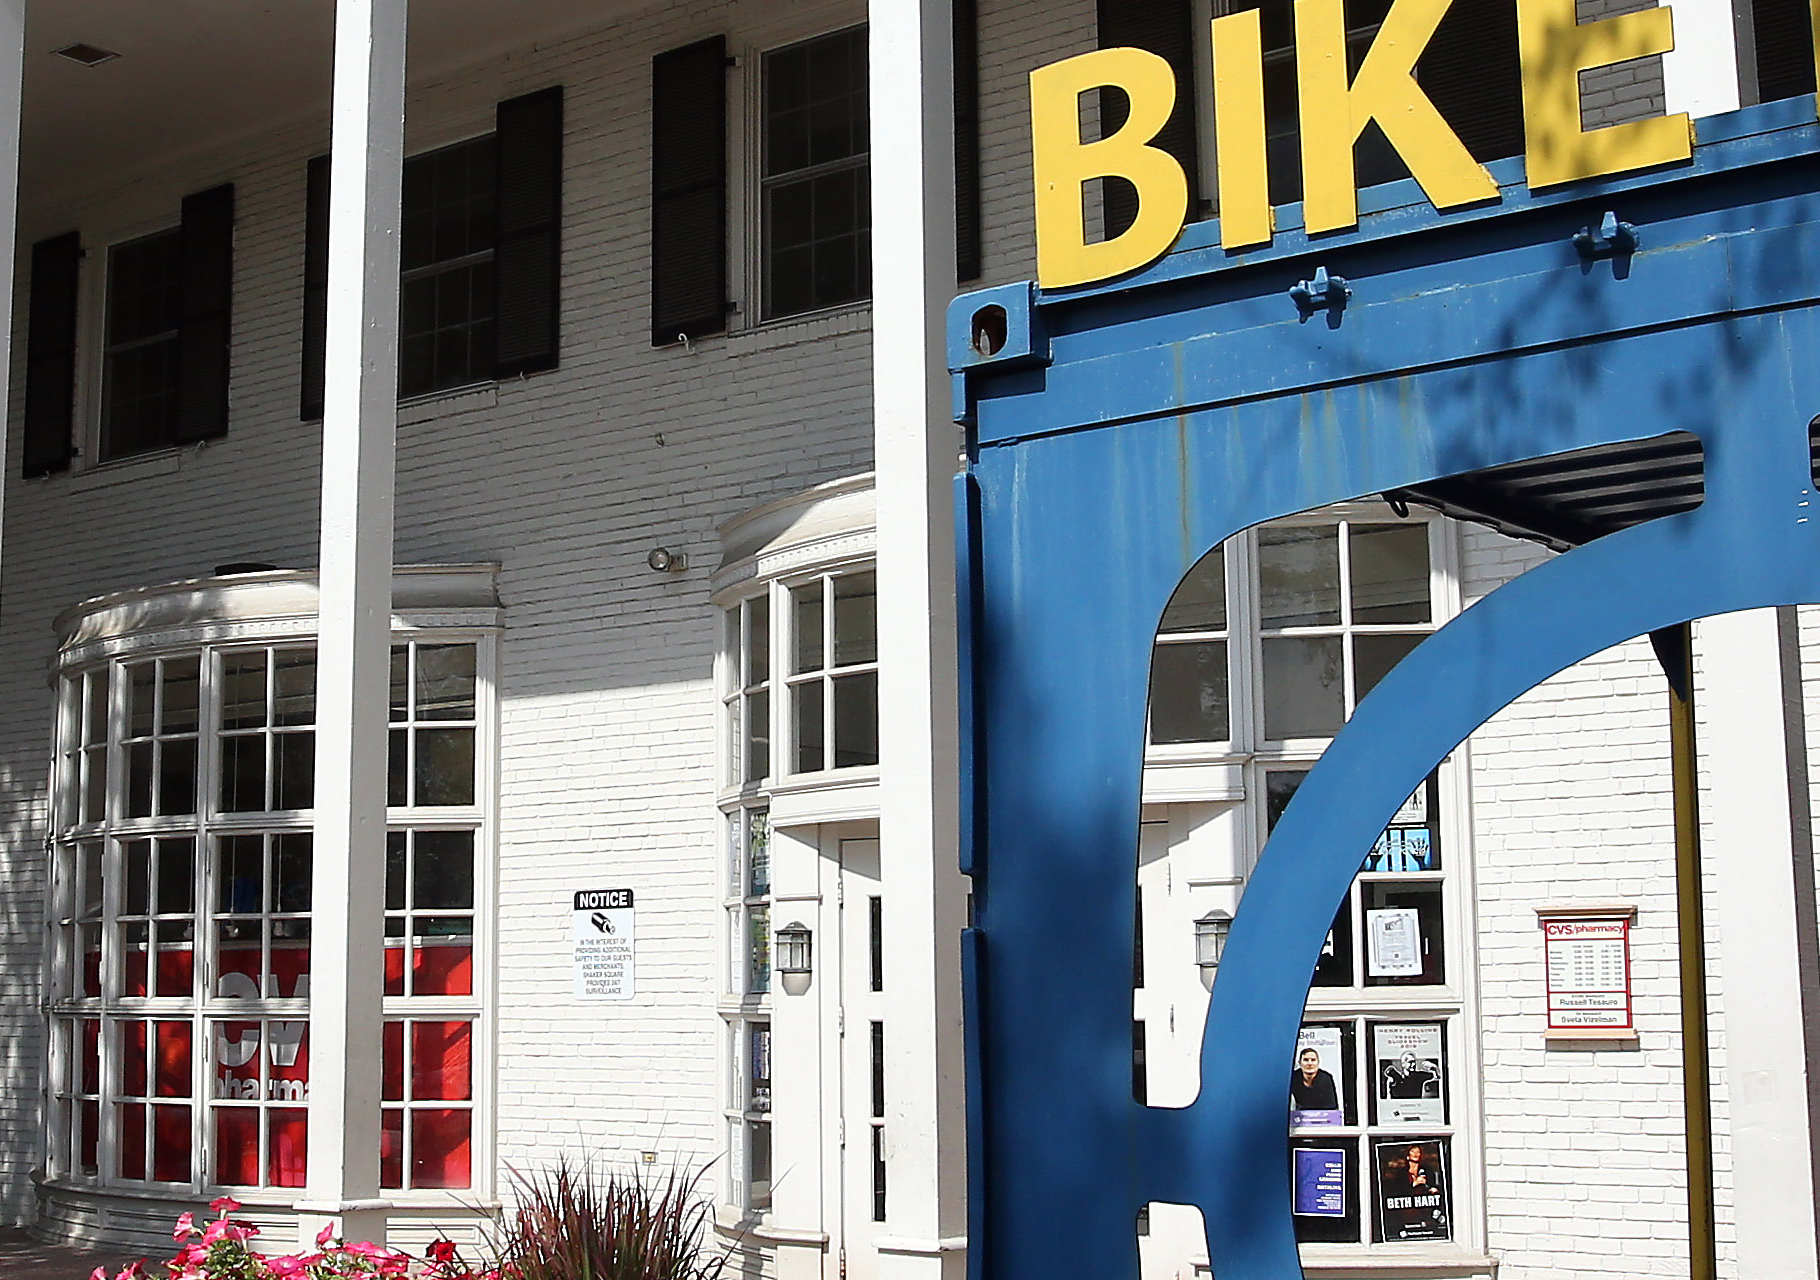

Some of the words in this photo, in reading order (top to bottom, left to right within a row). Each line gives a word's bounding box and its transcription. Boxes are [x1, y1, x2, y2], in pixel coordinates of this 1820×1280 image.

[579, 891, 628, 908] NOTICE
[1547, 923, 1623, 935] CVS/pharmacy
[1386, 1197, 1412, 1209] BETH
[1413, 1194, 1441, 1208] HART
